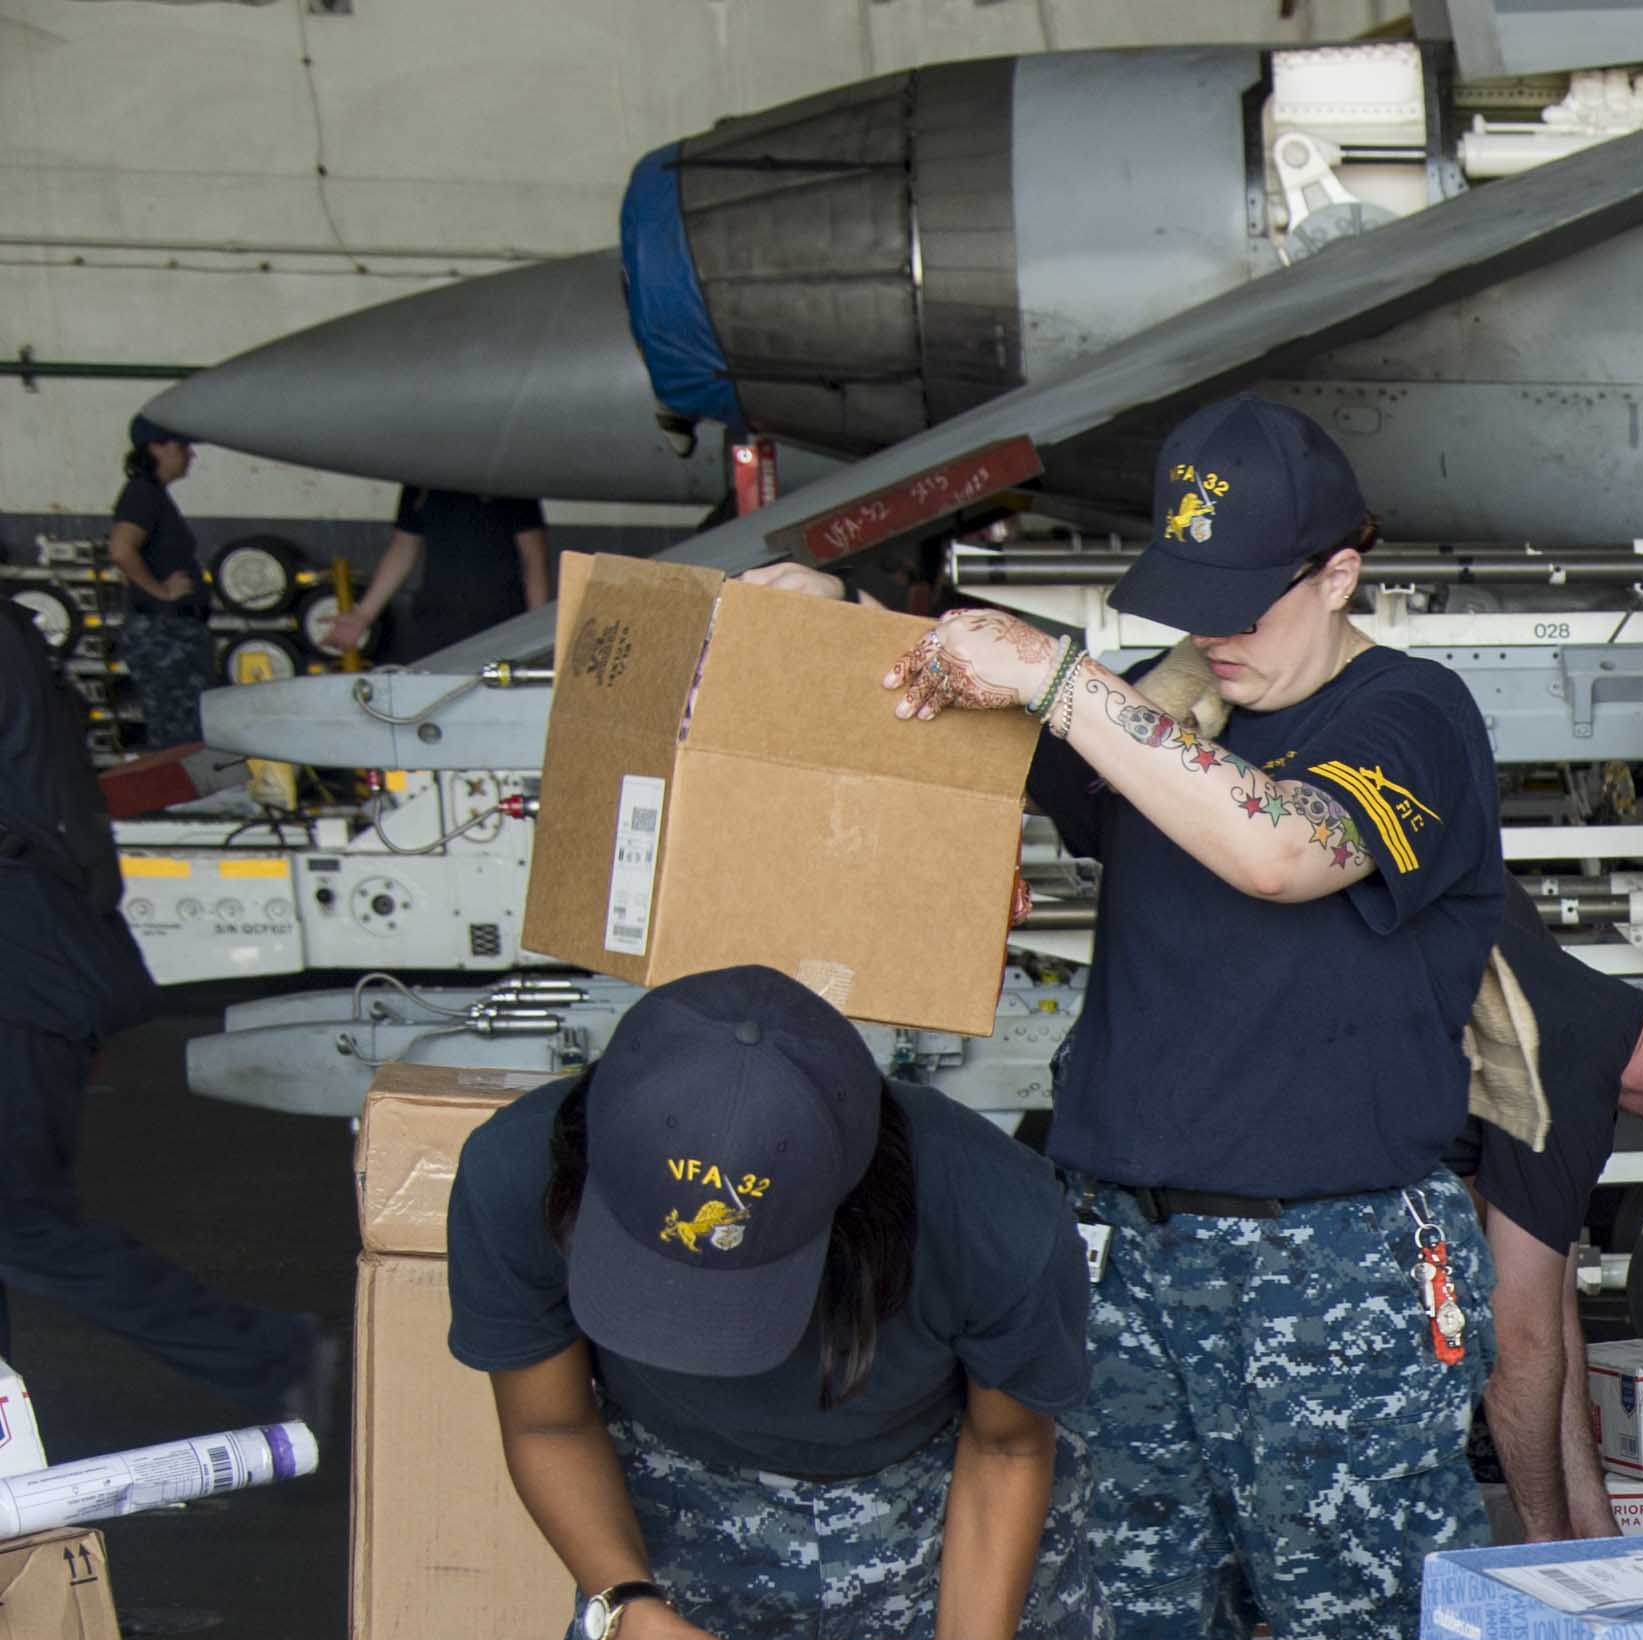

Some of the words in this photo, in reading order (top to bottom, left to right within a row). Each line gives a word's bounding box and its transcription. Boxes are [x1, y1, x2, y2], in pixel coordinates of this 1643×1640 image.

[1203, 472, 1231, 497] 32
[1534, 623, 1571, 640] 028
[668, 1158, 723, 1189] VFA
[739, 1174, 772, 1198] 32
